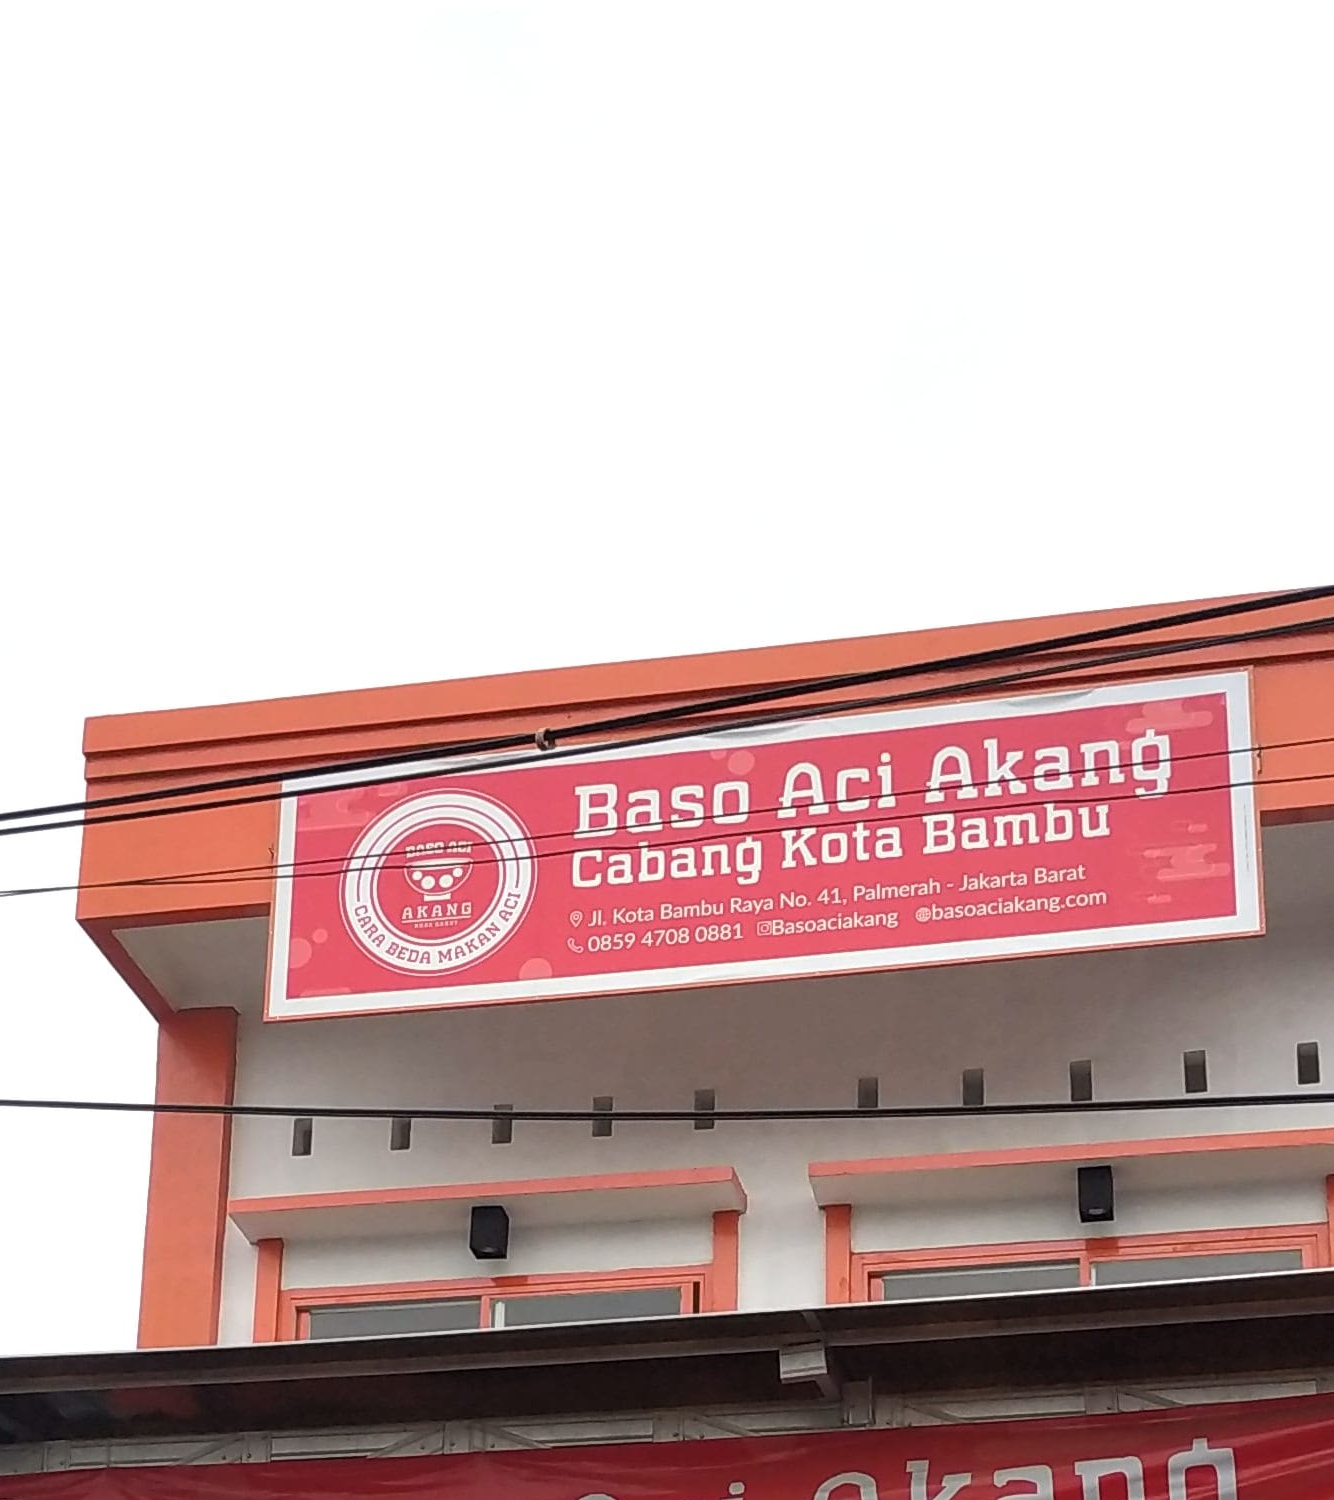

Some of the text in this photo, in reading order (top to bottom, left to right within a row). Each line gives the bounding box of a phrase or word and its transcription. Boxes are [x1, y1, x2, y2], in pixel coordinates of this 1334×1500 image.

[573, 729, 1173, 838] Baso Aci Akang
[572, 802, 1112, 888] Cabang Kota Bambu
[354, 892, 521, 965] CARA BEDA MAKAN ACI
[401, 902, 472, 920] AKANG
[587, 890, 1108, 953] 0859 4708 0881 Basoaciakang basoaciakang.com
[613, 905, 655, 925] Kota
[660, 899, 725, 921] Bambu
[730, 895, 775, 916] Raya
[780, 891, 812, 910] No.
[817, 887, 848, 907] 41,
[852, 878, 941, 902] Palmerah
[958, 871, 1029, 893] Jakarta
[1034, 864, 1087, 885] Barat
